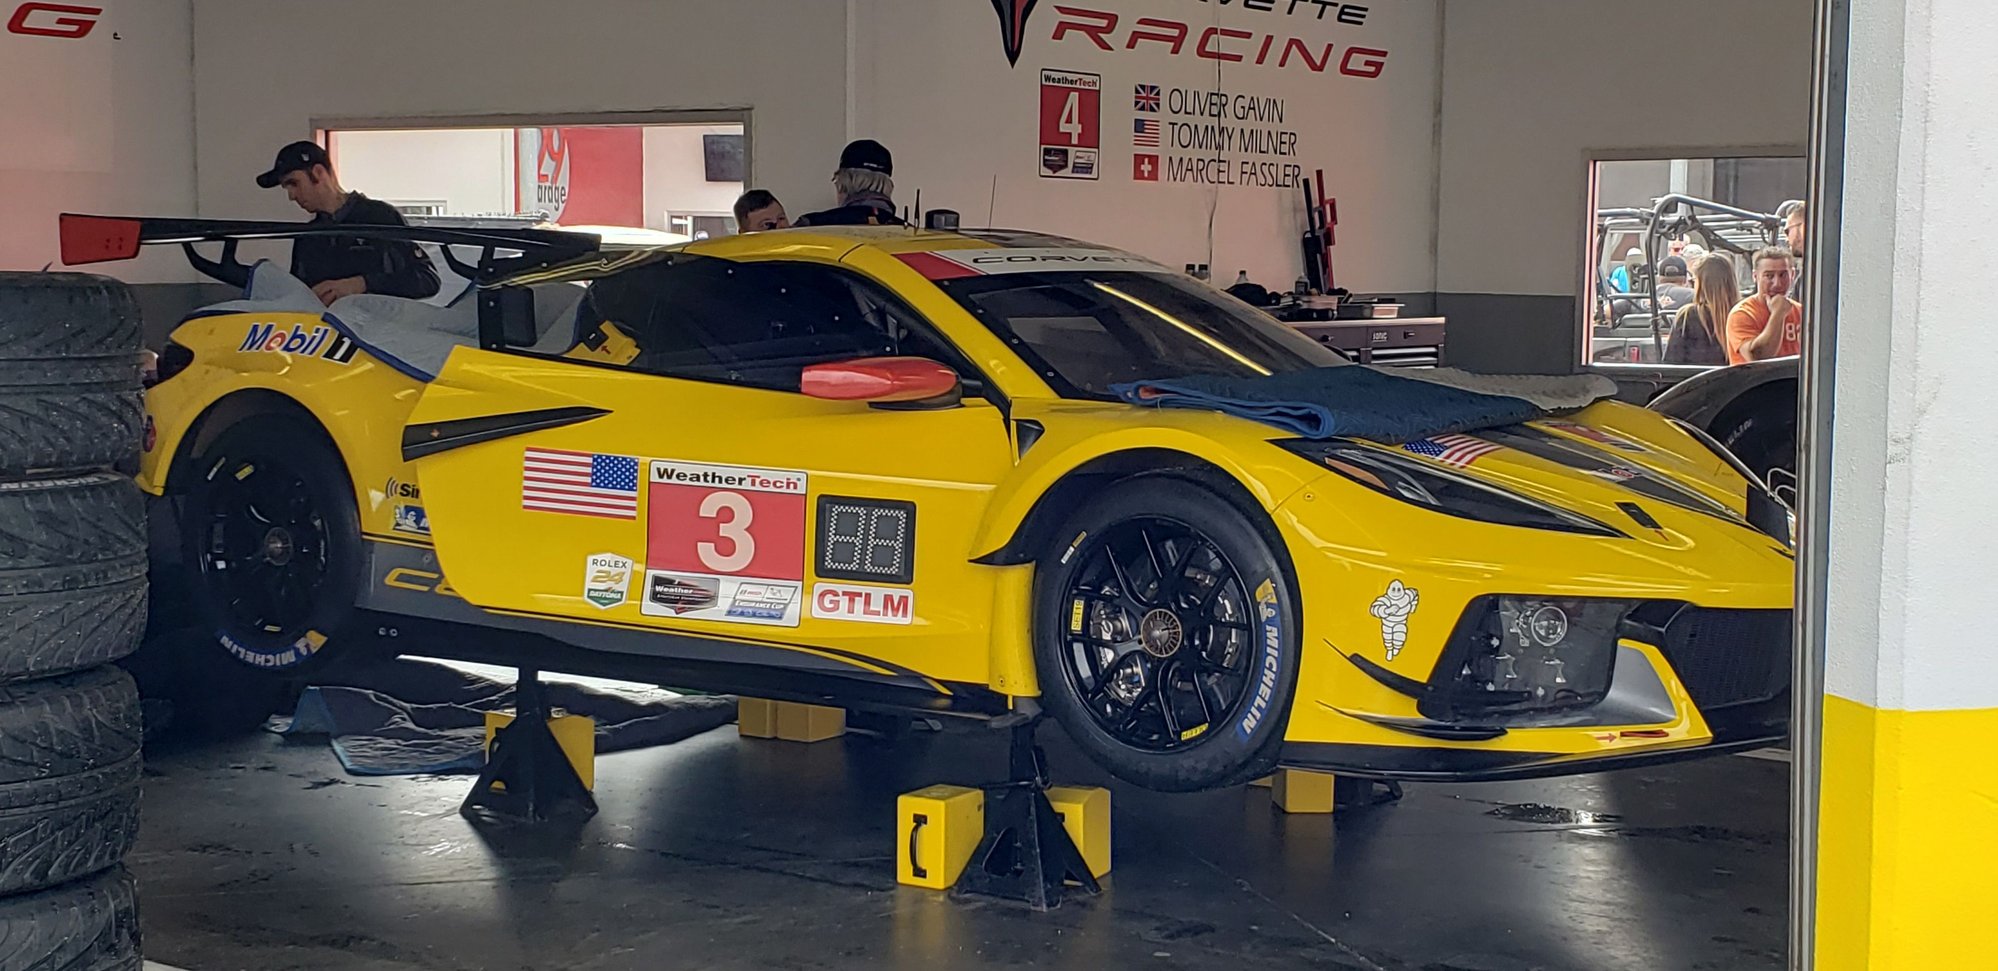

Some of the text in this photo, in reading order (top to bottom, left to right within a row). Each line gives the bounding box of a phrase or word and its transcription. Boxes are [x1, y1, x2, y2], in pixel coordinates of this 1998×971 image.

[1051, 5, 1389, 79] RACING
[1043, 74, 1098, 88] WeatherTech
[1059, 91, 1082, 145] 4
[1168, 88, 1284, 124] OLIVER GAVIN
[537, 128, 564, 185] 29
[1168, 122, 1297, 157] TOMMY MILNER
[1167, 156, 1301, 189] MARCEL FASSLER
[237, 323, 329, 356] Mobil
[697, 490, 755, 573] 3
[590, 569, 626, 585] 24
[592, 558, 628, 569] ROLEX
[817, 589, 909, 618] GTLM
[220, 635, 296, 667] MICHELIN
[1242, 624, 1279, 734] MICHELIN
